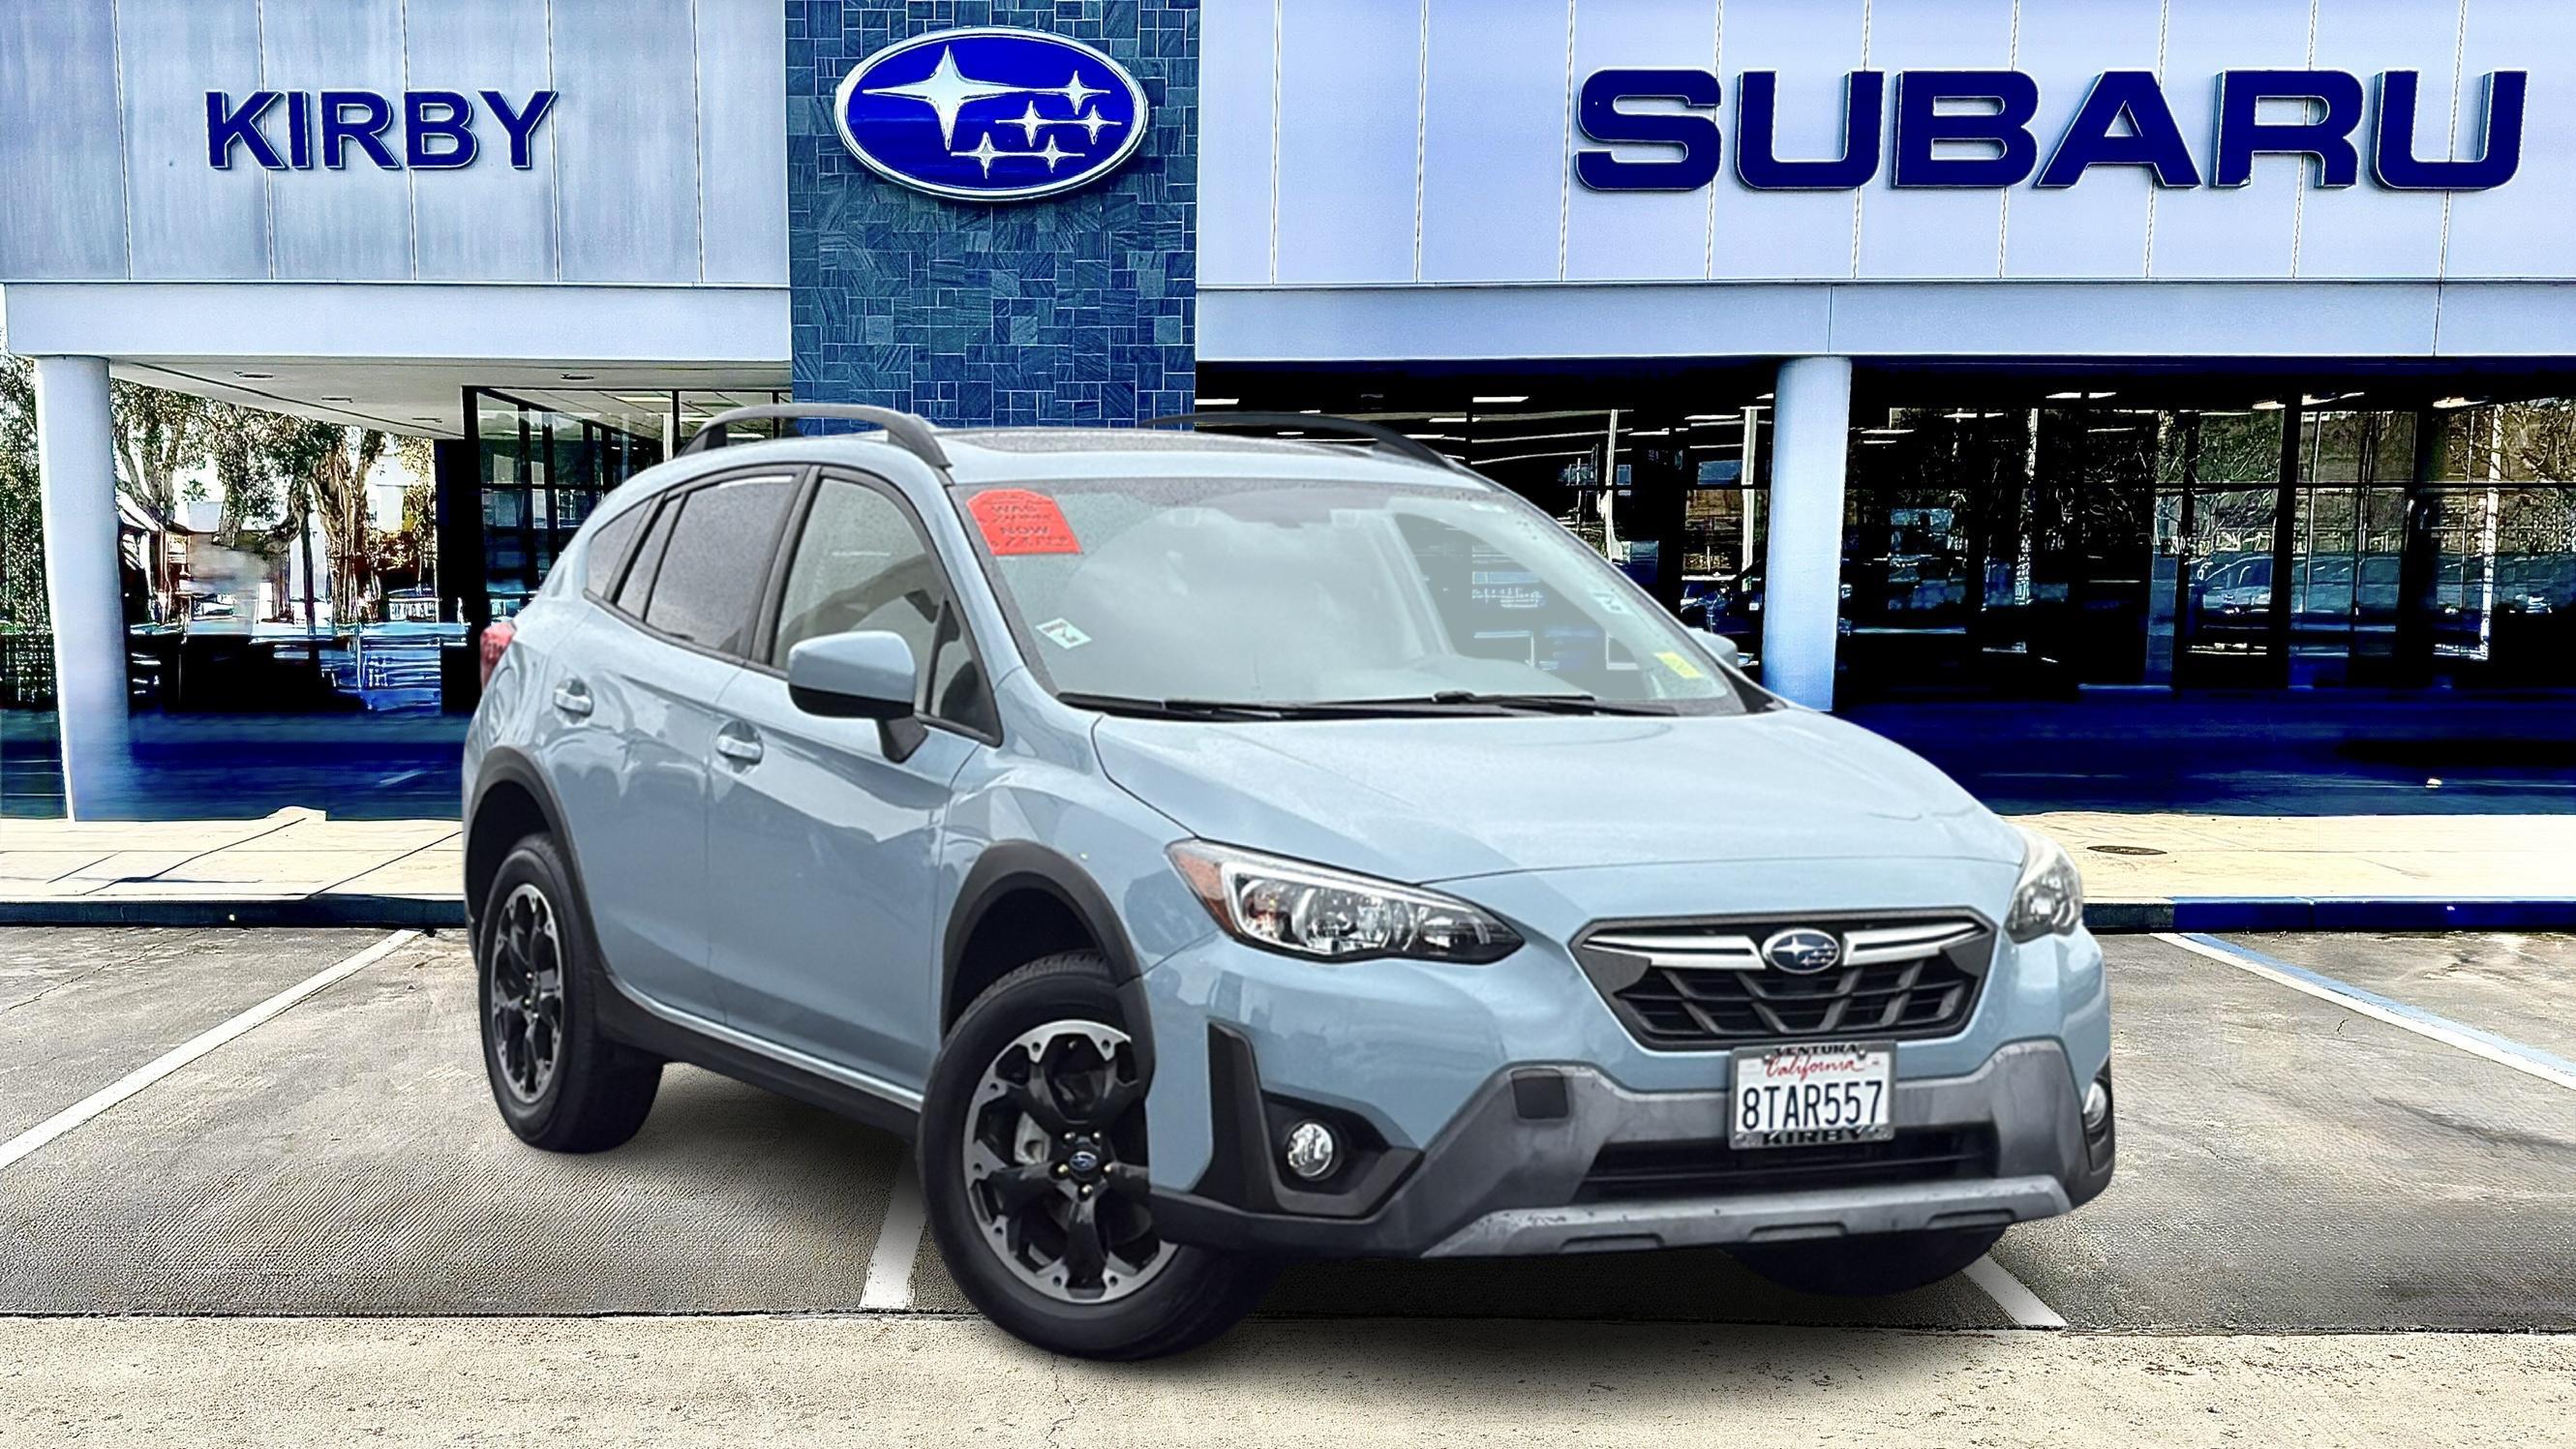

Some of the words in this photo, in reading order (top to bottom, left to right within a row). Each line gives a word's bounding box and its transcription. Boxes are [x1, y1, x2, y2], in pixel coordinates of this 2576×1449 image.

[205, 89, 559, 170] KIRBY
[1575, 68, 2530, 194] SUBARU
[1766, 1054, 1864, 1082] California
[1775, 1043, 1857, 1056] VENTURA
[1743, 1079, 1883, 1131] 8TAR557
[1763, 1127, 1863, 1145] KIRBY
